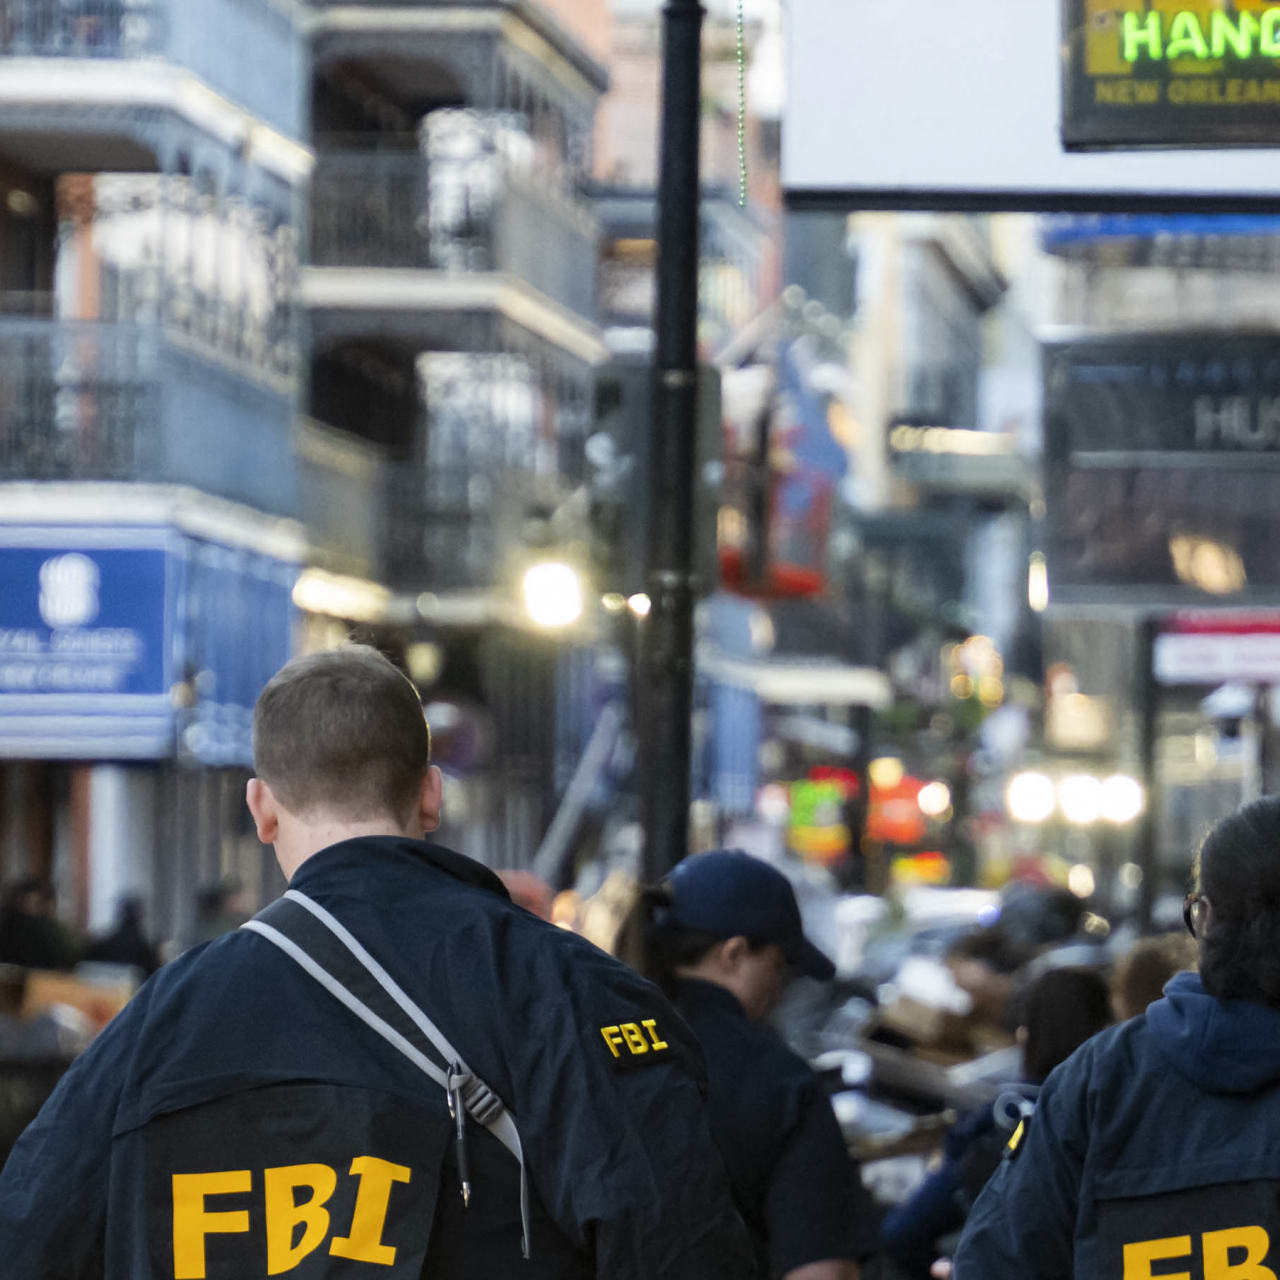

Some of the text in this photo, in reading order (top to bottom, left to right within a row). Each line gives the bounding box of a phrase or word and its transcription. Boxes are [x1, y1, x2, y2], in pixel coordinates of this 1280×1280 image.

[1094, 78, 1159, 104] NEW
[601, 1019, 669, 1058] FBI
[172, 1155, 412, 1280] FBI
